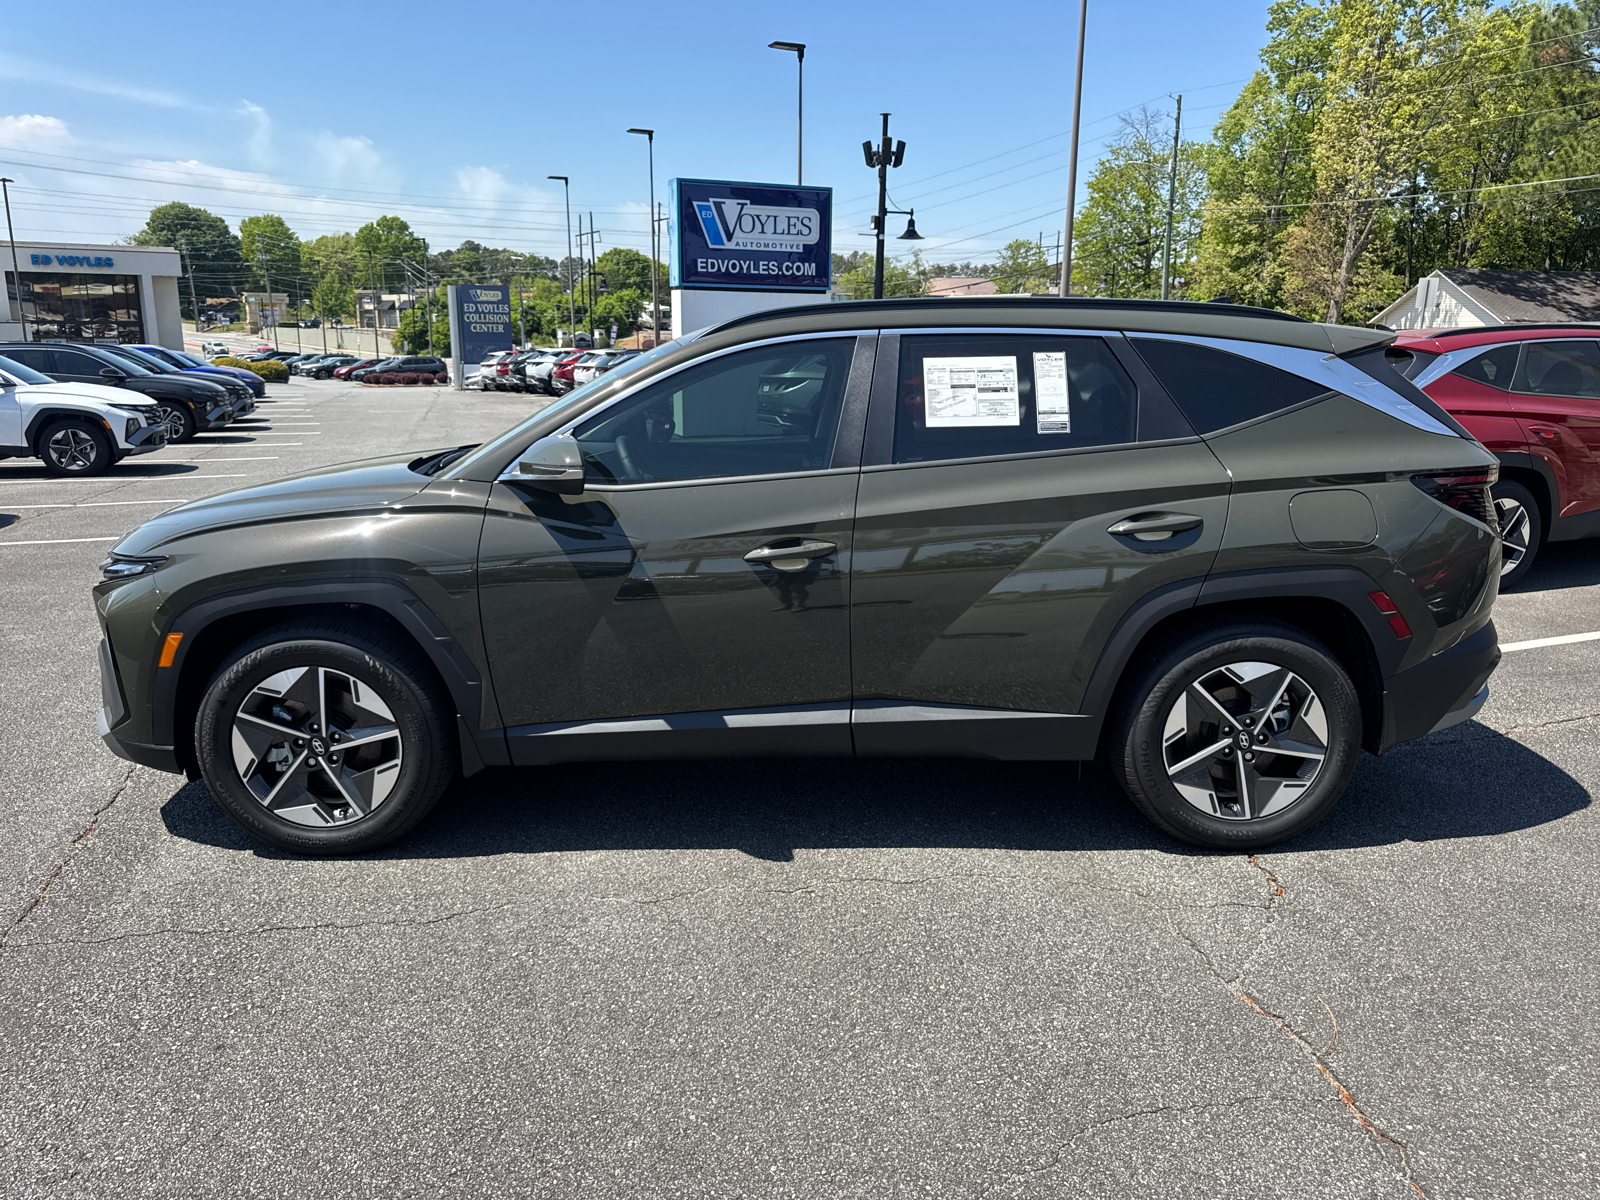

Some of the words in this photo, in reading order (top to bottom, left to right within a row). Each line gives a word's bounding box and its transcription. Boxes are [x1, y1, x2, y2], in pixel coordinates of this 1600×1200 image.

[701, 210, 713, 219] ED
[712, 200, 812, 242] VOYLES
[734, 241, 801, 250] AUTOMOTIVE
[30, 254, 53, 266] ED
[55, 255, 115, 268] VOYLES
[697, 258, 816, 276] EDVOYLES.COM
[463, 303, 476, 312] ED
[477, 304, 510, 313] VOYLES
[464, 313, 510, 323] COLLISION
[470, 323, 505, 333] CENTER
[1140, 739, 1164, 801] KUMHO
[215, 779, 264, 832] KUMHO
